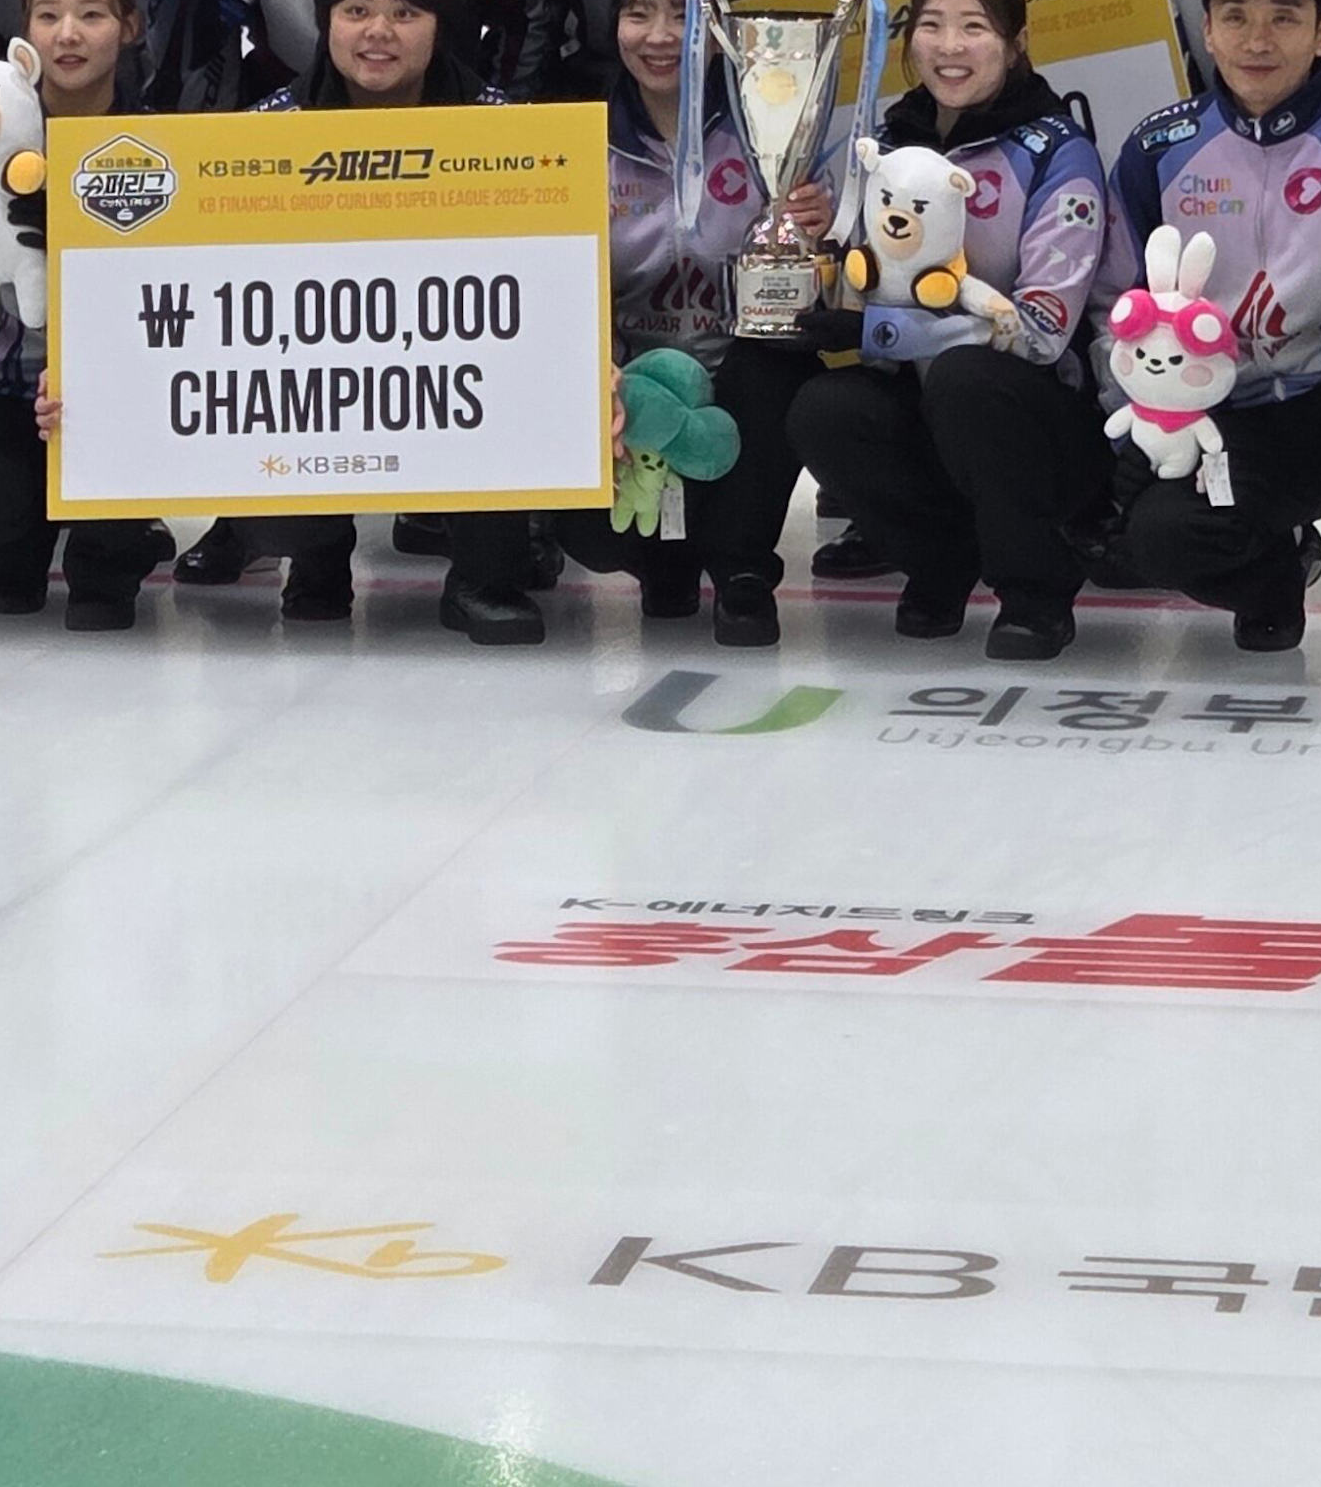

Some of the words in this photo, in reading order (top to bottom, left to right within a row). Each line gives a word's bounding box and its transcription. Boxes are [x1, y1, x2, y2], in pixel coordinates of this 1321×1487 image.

[298, 148, 435, 186] 슈퍼리그
[438, 155, 536, 173] CURLING
[80, 173, 166, 198] 슈퍼리그
[169, 364, 486, 437] CHAMPIONS
[876, 726, 1217, 756] Uijeongbu
